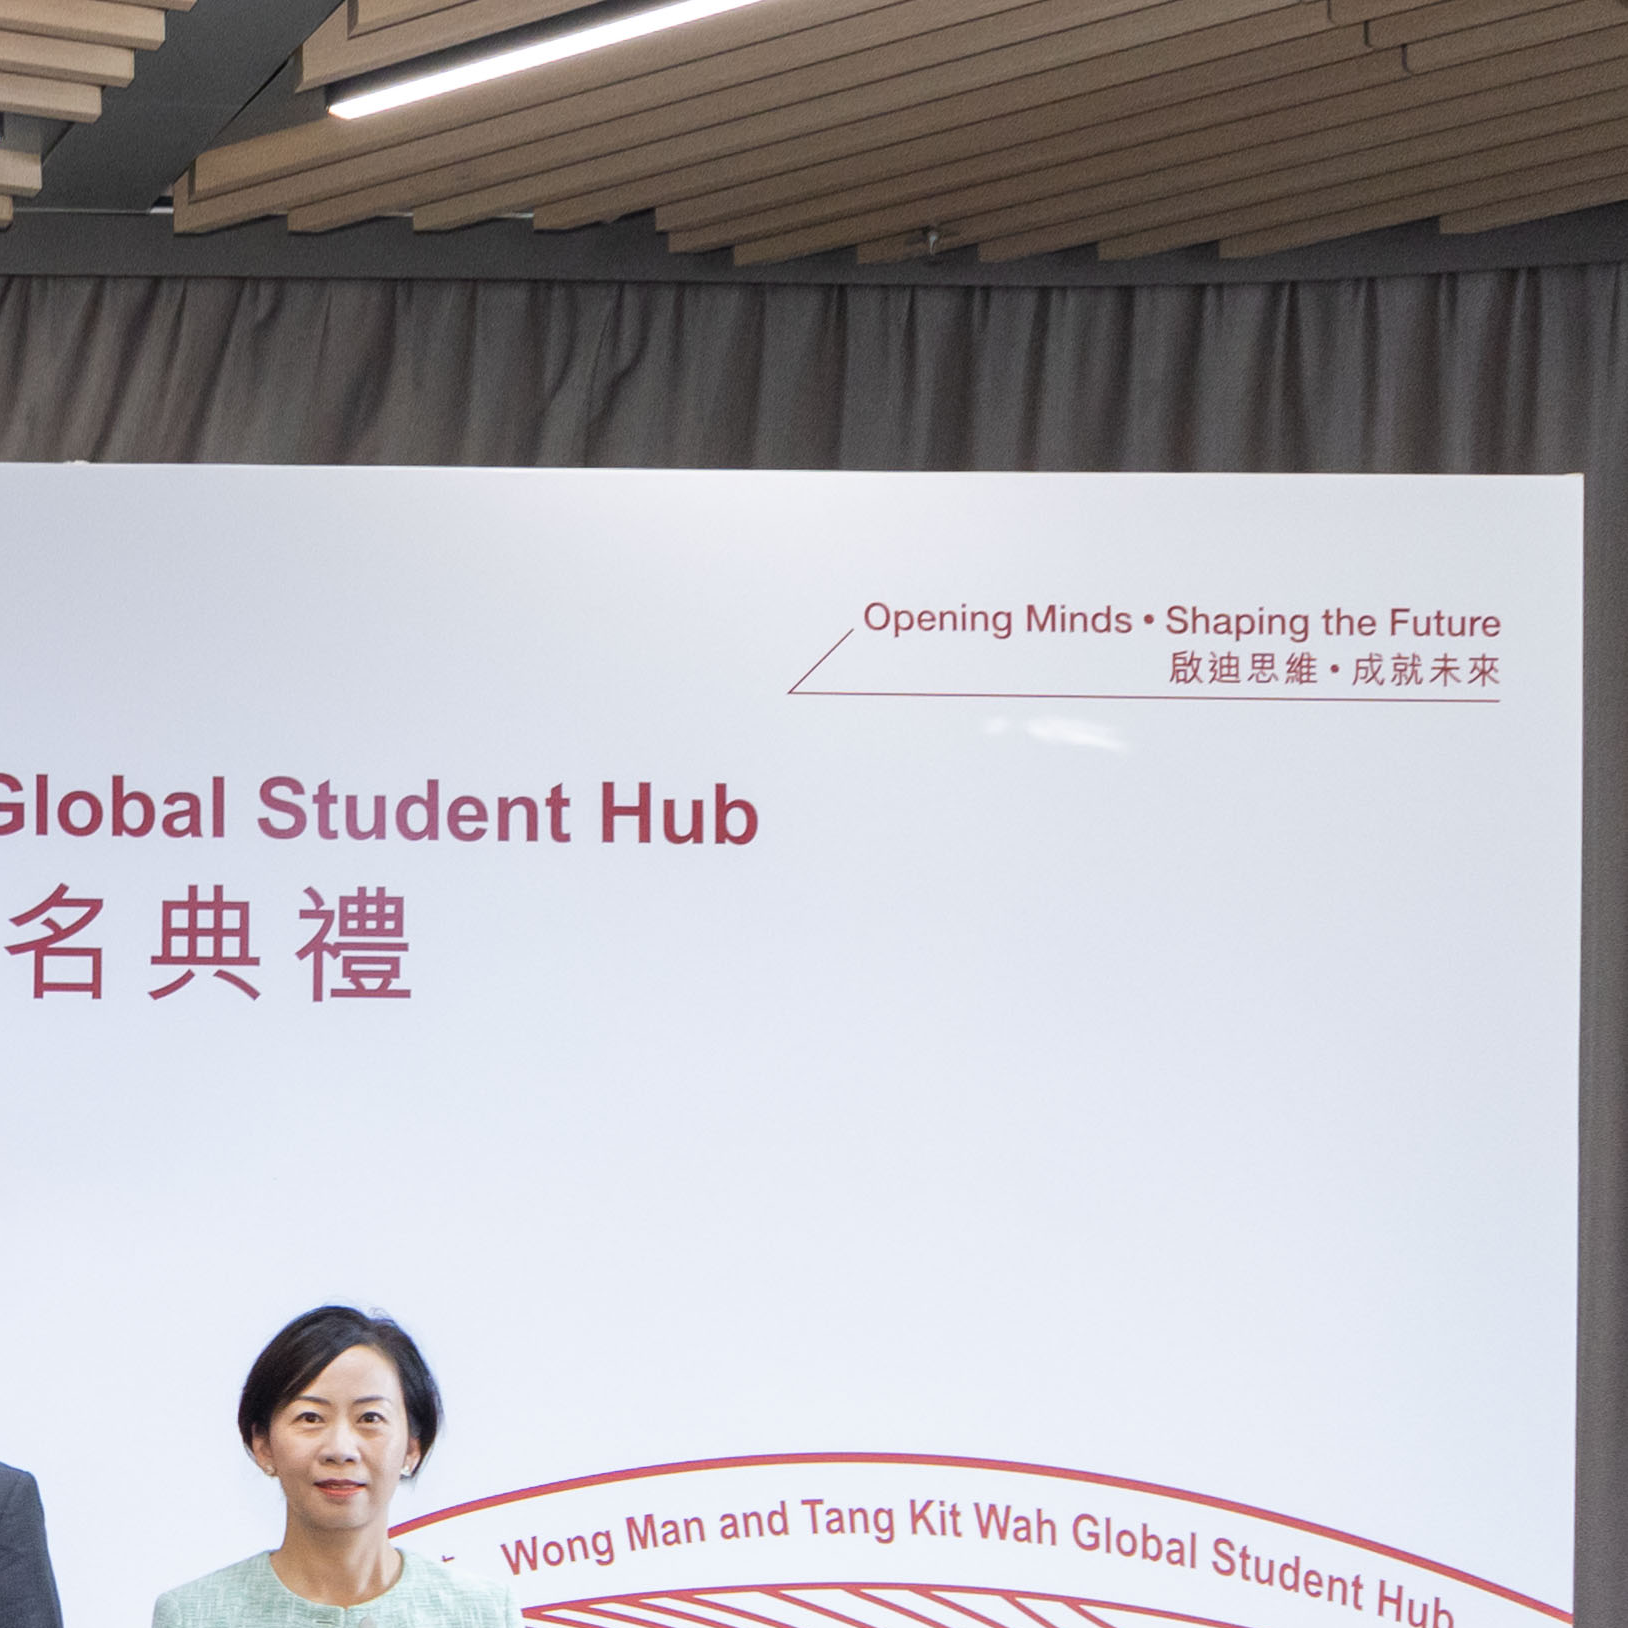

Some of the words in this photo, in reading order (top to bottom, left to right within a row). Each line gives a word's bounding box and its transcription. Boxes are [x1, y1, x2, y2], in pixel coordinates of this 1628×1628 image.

[864, 602, 1013, 641] Opening
[1027, 604, 1133, 635] Minds
[1166, 606, 1311, 643] Shaping
[1321, 607, 1378, 638] the
[1390, 608, 1503, 639] Future
[257, 776, 573, 845] Student
[602, 781, 760, 847] Hub
[500, 1530, 615, 1575] Wong
[625, 1513, 706, 1552] Man
[720, 1501, 789, 1541] and
[800, 1499, 895, 1545] Tang
[910, 1499, 962, 1538] Kit
[974, 1503, 1057, 1546] Wah
[1072, 1513, 1197, 1569] Global
[1212, 1537, 1363, 1611] Student
